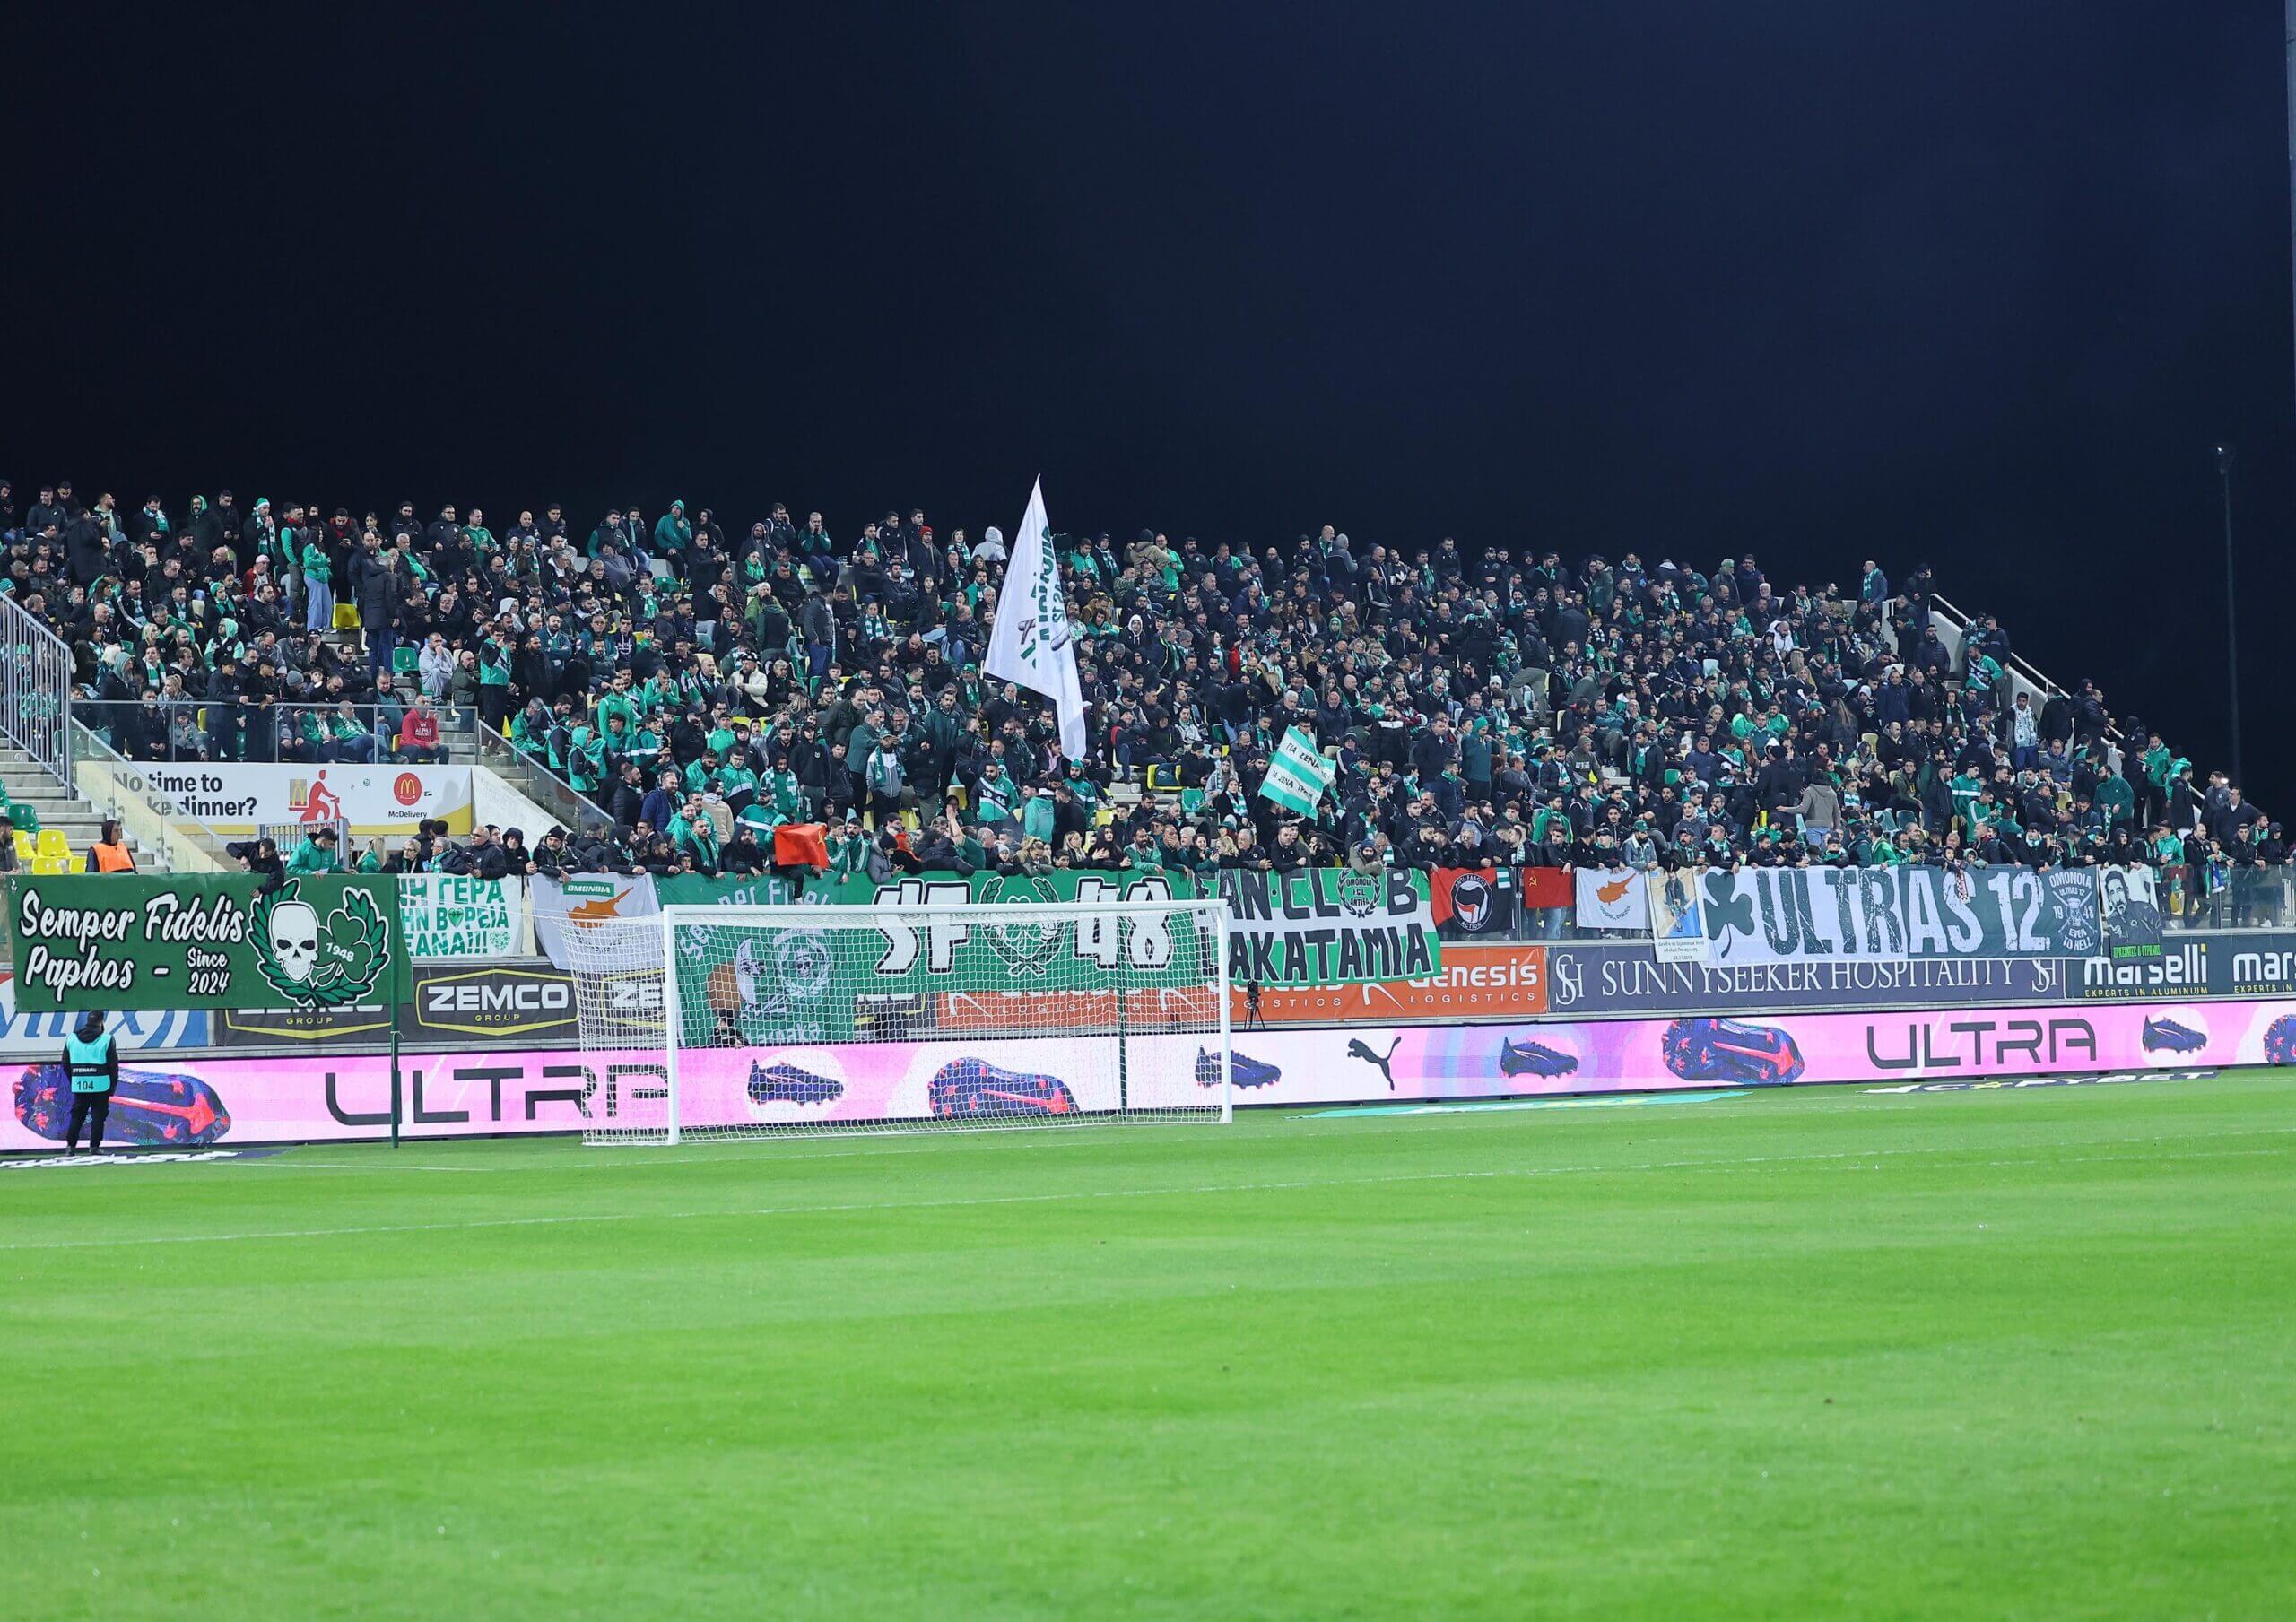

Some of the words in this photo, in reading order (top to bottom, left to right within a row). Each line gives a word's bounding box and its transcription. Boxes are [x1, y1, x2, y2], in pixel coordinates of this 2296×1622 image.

[149, 771, 196, 792] time
[201, 774, 223, 792] to
[177, 795, 257, 816] dinner?
[388, 811, 428, 819] McDelivery
[567, 885, 611, 893] OMONOIA
[1346, 877, 1372, 887] OMONOIA
[2049, 871, 2092, 889] OMONOIA
[20, 889, 135, 953] Semper
[145, 892, 244, 942] Fidelis
[1755, 870, 1984, 955] ULTRAS
[1988, 872, 2050, 951] 12
[2053, 906, 2064, 919] 19
[2083, 905, 2094, 919] 48
[873, 878, 971, 975] SF
[1074, 877, 1173, 971] 48
[1460, 921, 1483, 930] ACTION
[2069, 928, 2087, 938] EVEN
[326, 942, 355, 962] 1948
[2063, 936, 2073, 950] TO
[2074, 937, 2094, 951] HELL
[187, 947, 228, 968] Since
[24, 945, 135, 1002] Paphos
[2233, 952, 2296, 983] mar
[188, 972, 230, 994] 2024
[1602, 959, 1823, 996] SUNNYSEEKER
[428, 984, 569, 1011] ZEMCO
[1410, 993, 1535, 1003] LOGISTICS
[2085, 989, 2129, 997] EXPERTS
[2135, 988, 2145, 996] IN
[2152, 987, 2208, 996] ALUMINIUM
[2234, 984, 2276, 993] EXPERTS
[2282, 984, 2292, 992] IN
[286, 1017, 334, 1025] GROUP
[475, 1013, 520, 1023] GROUP
[1867, 1019, 2096, 1070] ULTRA
[77, 1080, 94, 1090] 104
[325, 1064, 668, 1125] ULTRA
